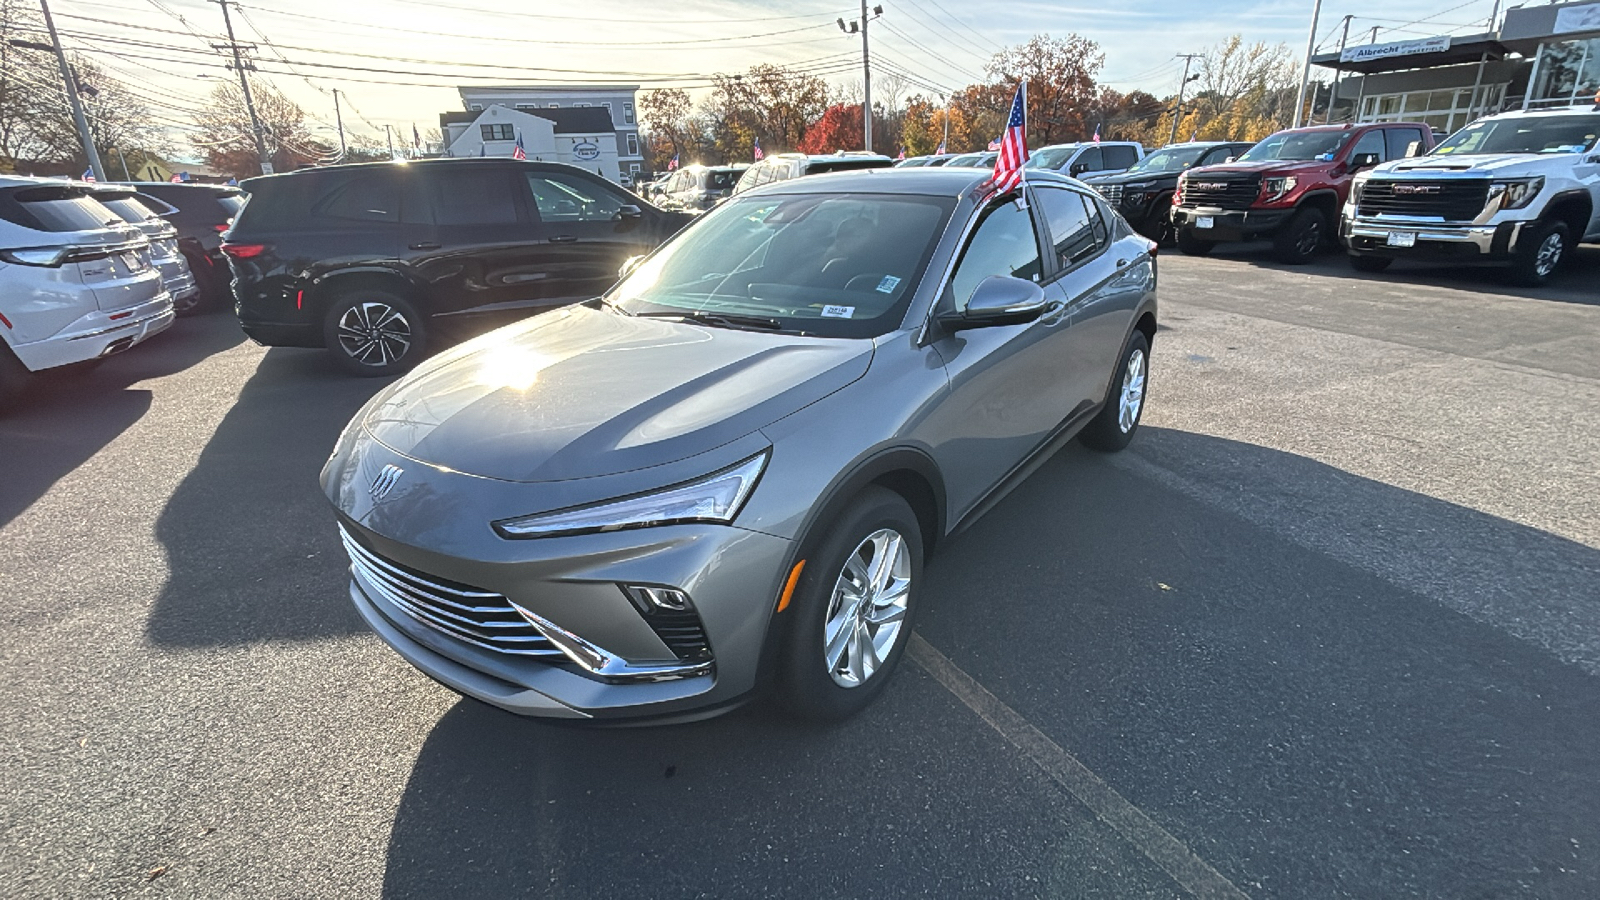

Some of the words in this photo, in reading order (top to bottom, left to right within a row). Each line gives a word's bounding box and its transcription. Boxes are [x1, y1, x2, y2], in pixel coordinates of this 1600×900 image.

[1357, 45, 1399, 57] Albrecht
[1199, 182, 1228, 191] GMC
[1394, 185, 1441, 194] GMC
